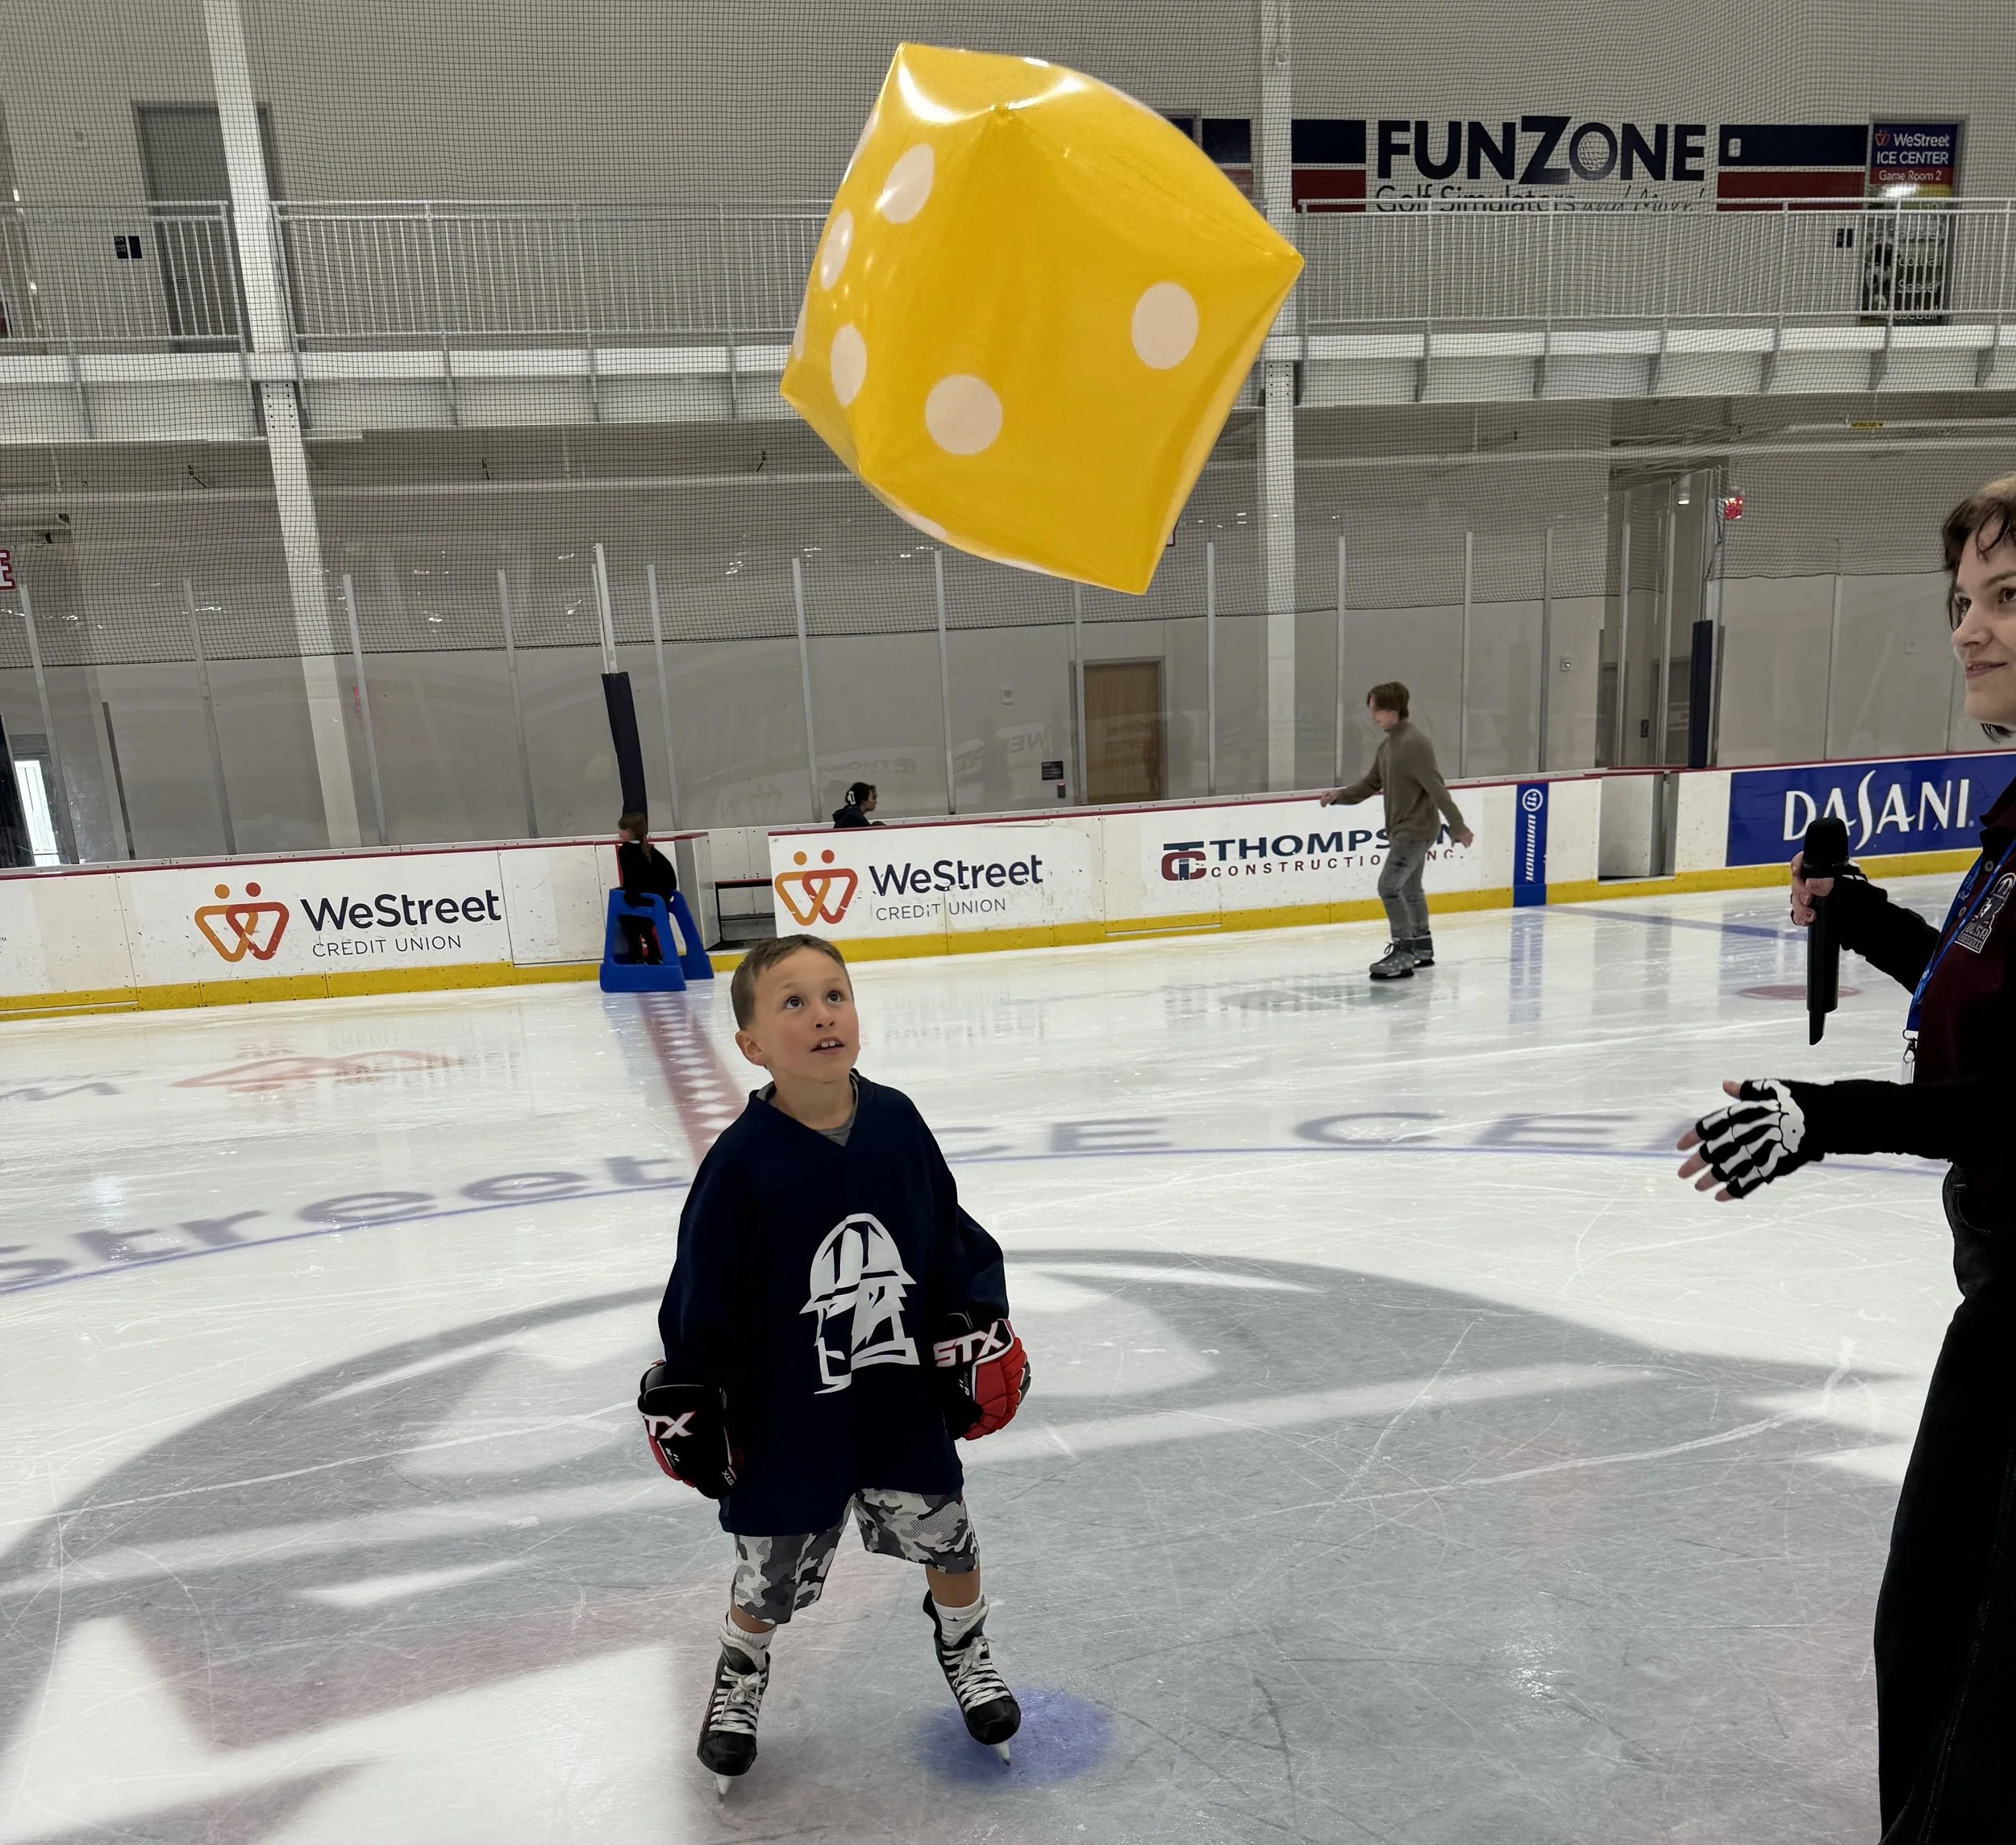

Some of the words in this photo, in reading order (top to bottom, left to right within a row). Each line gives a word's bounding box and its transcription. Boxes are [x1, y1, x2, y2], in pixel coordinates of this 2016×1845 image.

[1377, 115, 1706, 185] FUNZONE
[1893, 133, 1950, 148] WeStreet
[1876, 151, 1897, 165] ICE
[1899, 151, 1949, 165] CENTER
[1879, 170, 1906, 181] Game
[1907, 170, 1934, 181] Room
[1935, 170, 1943, 181] 2
[1376, 184, 1433, 212] Golf
[1782, 769, 1970, 852] DASANI
[1209, 823, 1455, 861] THOMPSN
[1525, 813, 1536, 882] WARRIOR
[868, 854, 1043, 897] WeStreet
[1211, 854, 1381, 877] CONSTRUCTIO
[1426, 849, 1464, 861] NC.
[300, 889, 502, 931] WeStreet
[876, 902, 940, 921] CREDIT
[949, 898, 1006, 915] UNION
[313, 939, 386, 957] CREDIT
[395, 935, 462, 952] UNION
[933, 1322, 1004, 1368] STX
[643, 1410, 697, 1439] TX
